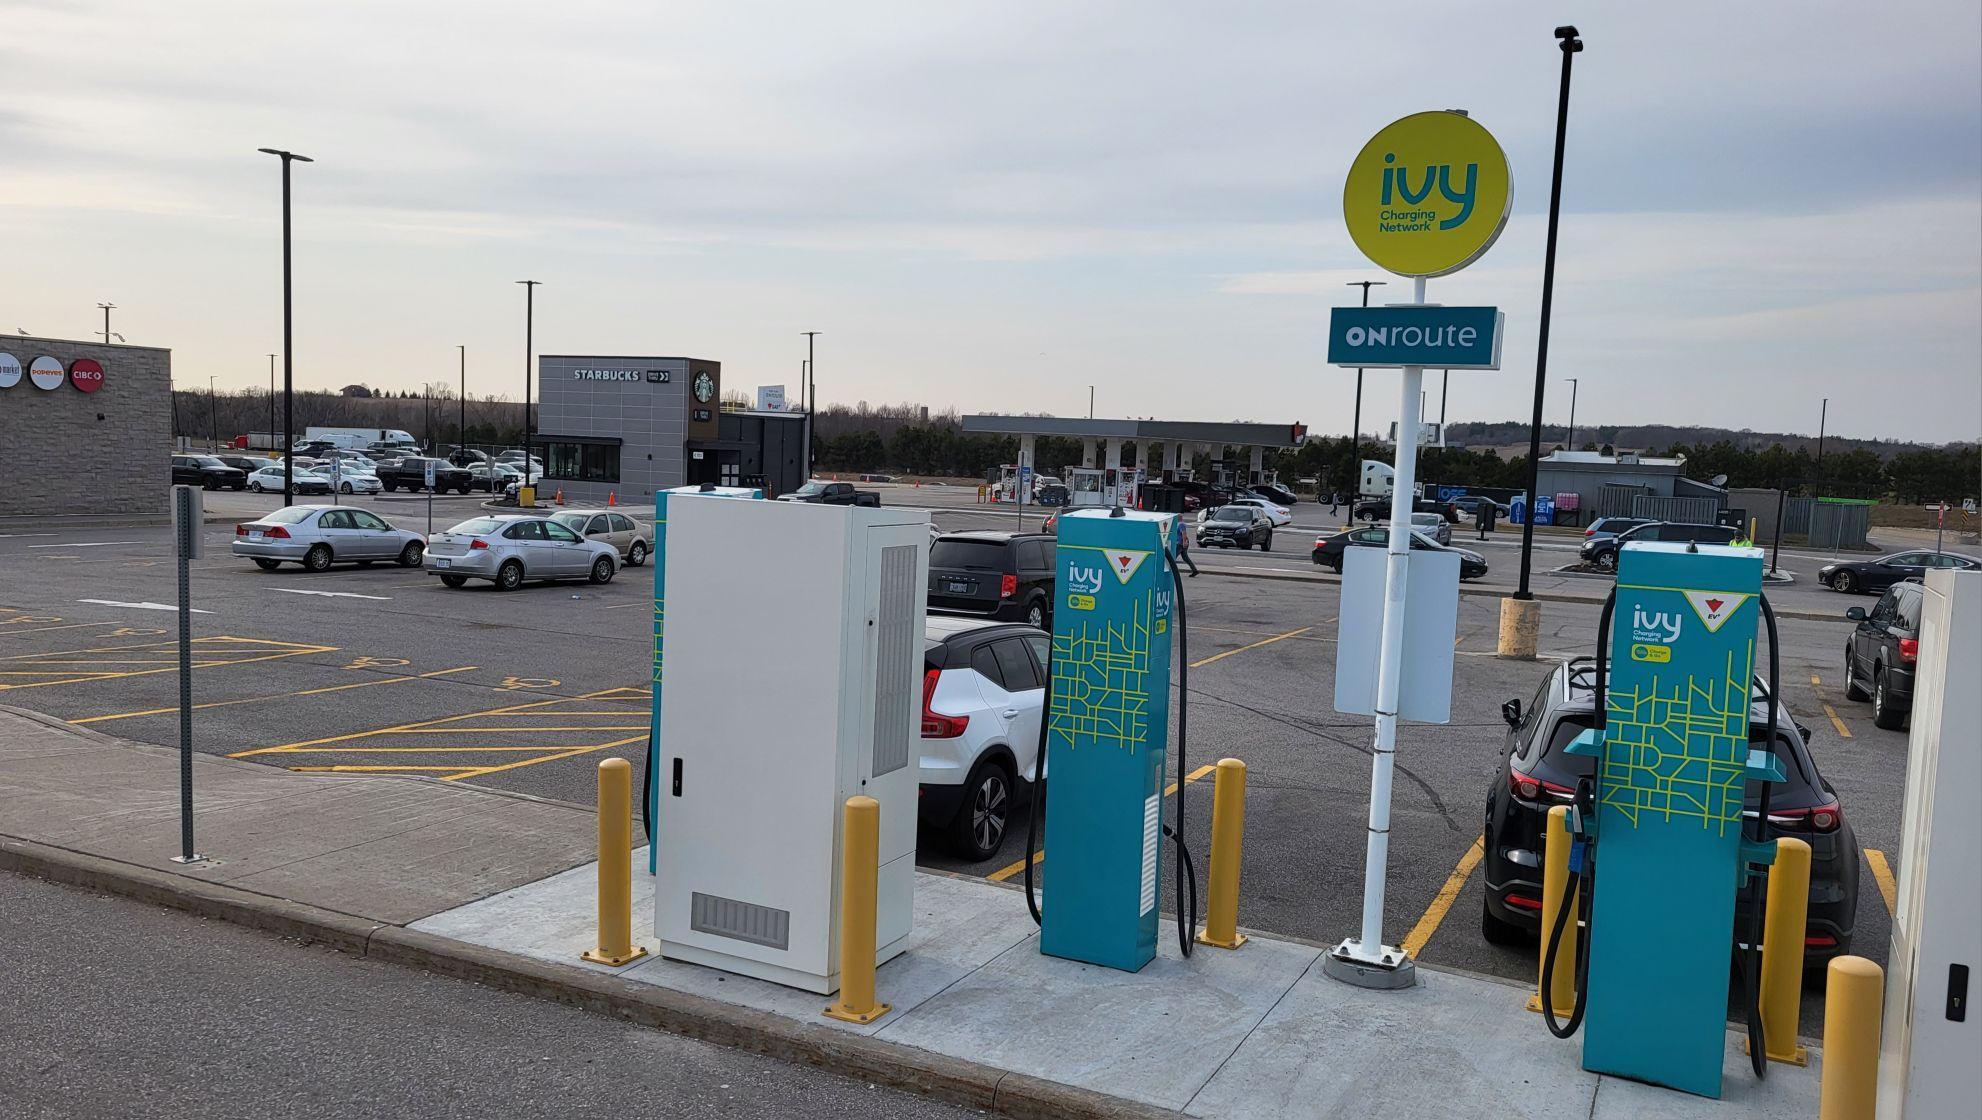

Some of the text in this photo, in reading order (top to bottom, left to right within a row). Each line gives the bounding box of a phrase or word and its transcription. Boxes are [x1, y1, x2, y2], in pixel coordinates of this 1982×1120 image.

[1381, 153, 1478, 231] ivy
[1380, 210, 1435, 222] Charging
[1380, 222, 1431, 232] Network
[73, 371, 93, 379] CIBC
[574, 369, 640, 381] STARBUCKS
[1069, 560, 1103, 594] ivy
[1156, 586, 1170, 617] ivy
[1633, 603, 1682, 643] ivy
[1633, 630, 1661, 638] Charging
